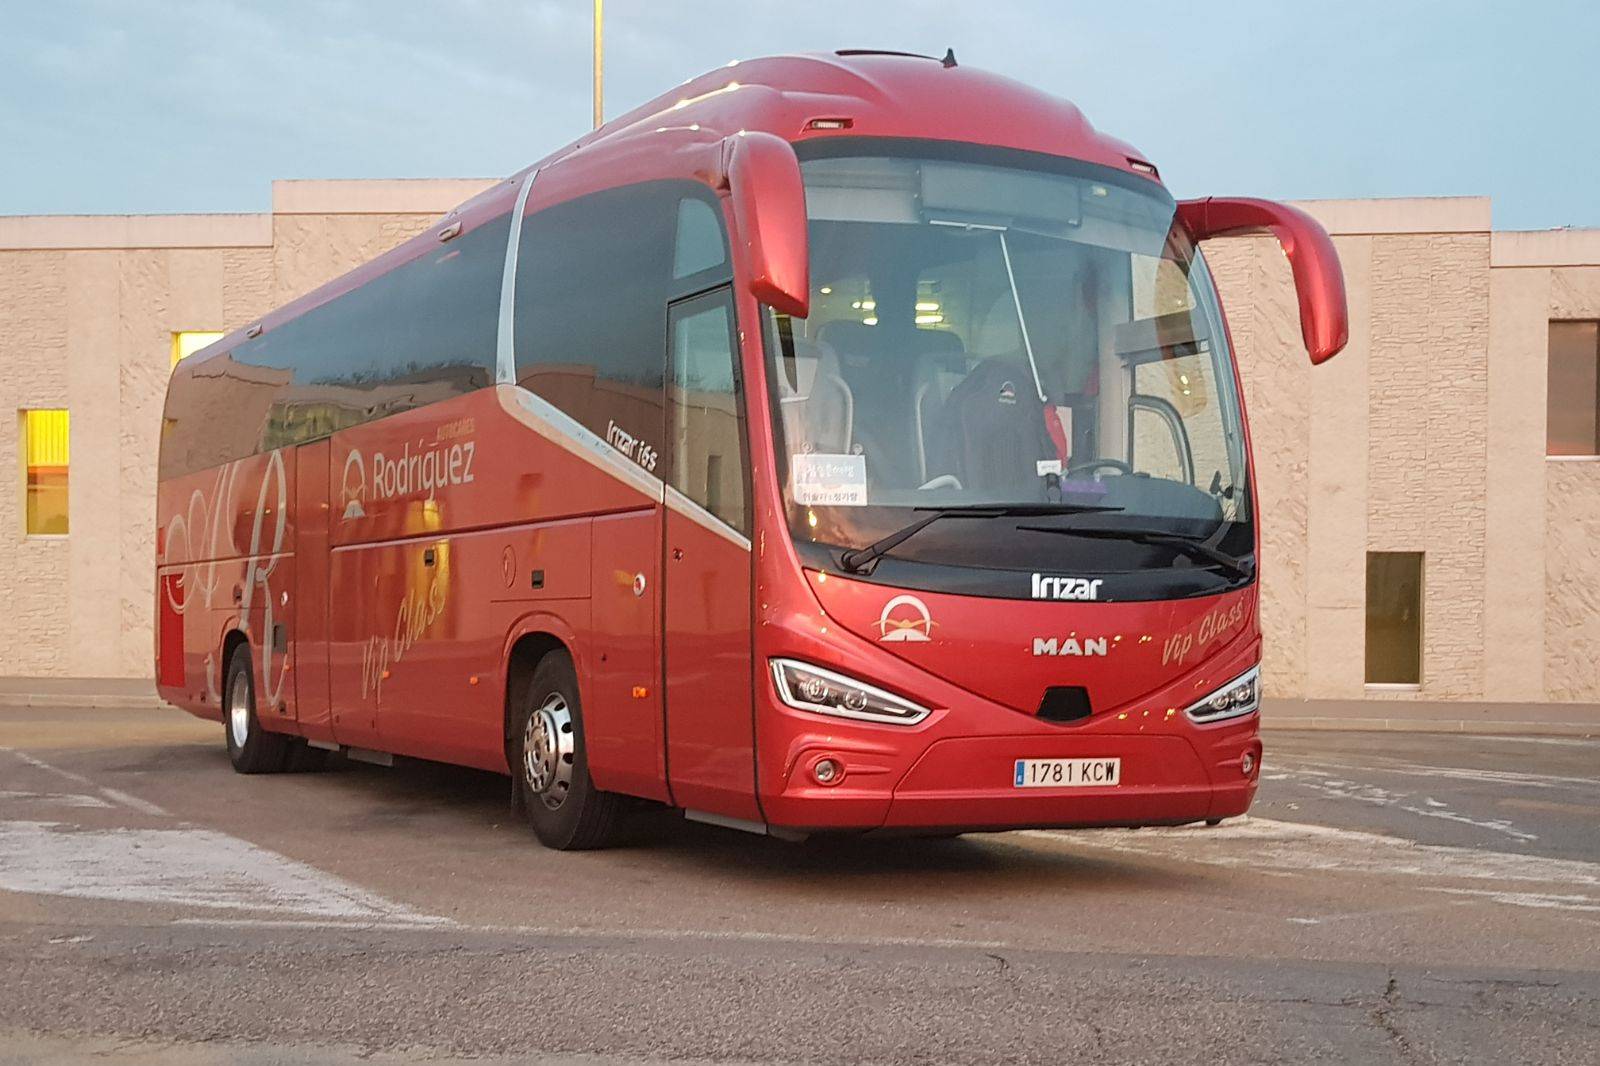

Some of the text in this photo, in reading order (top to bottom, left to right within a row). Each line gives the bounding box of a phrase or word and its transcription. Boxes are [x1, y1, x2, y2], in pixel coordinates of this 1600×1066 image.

[373, 438, 476, 501] Rodríguez
[606, 419, 658, 472] Irizar i6s
[1031, 573, 1103, 600] Irizar
[362, 577, 447, 705] Vip Class
[1033, 637, 1107, 656] MAN
[1162, 596, 1245, 666] Vip Class
[1031, 761, 1116, 783] 1781 KCW
